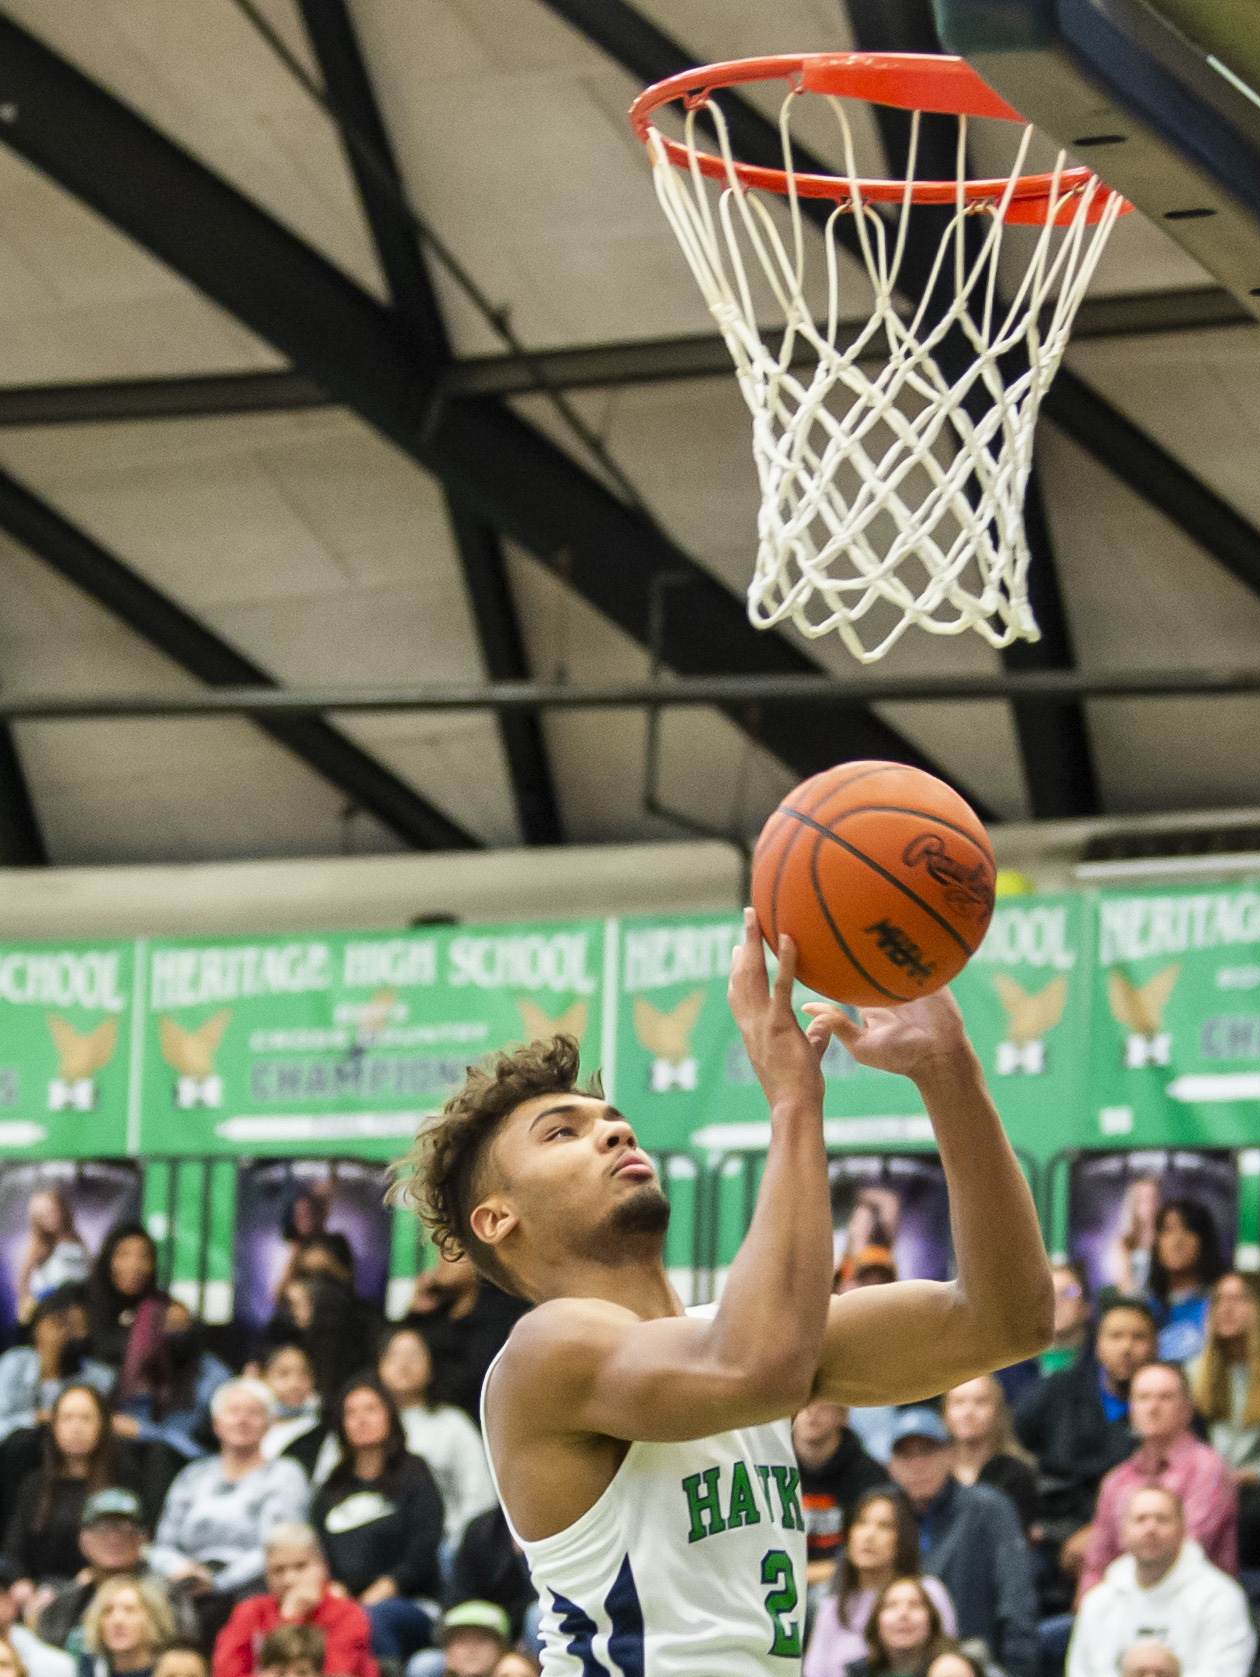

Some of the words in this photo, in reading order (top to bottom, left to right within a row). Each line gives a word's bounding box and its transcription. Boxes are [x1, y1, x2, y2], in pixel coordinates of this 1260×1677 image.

[152, 943, 332, 1010] HERITAGE
[345, 939, 437, 987] HIGH
[449, 931, 597, 995] SCHOOL
[624, 922, 748, 992] HERIT
[251, 1057, 474, 1101] CHAMPION
[760, 1549, 803, 1659] 2
